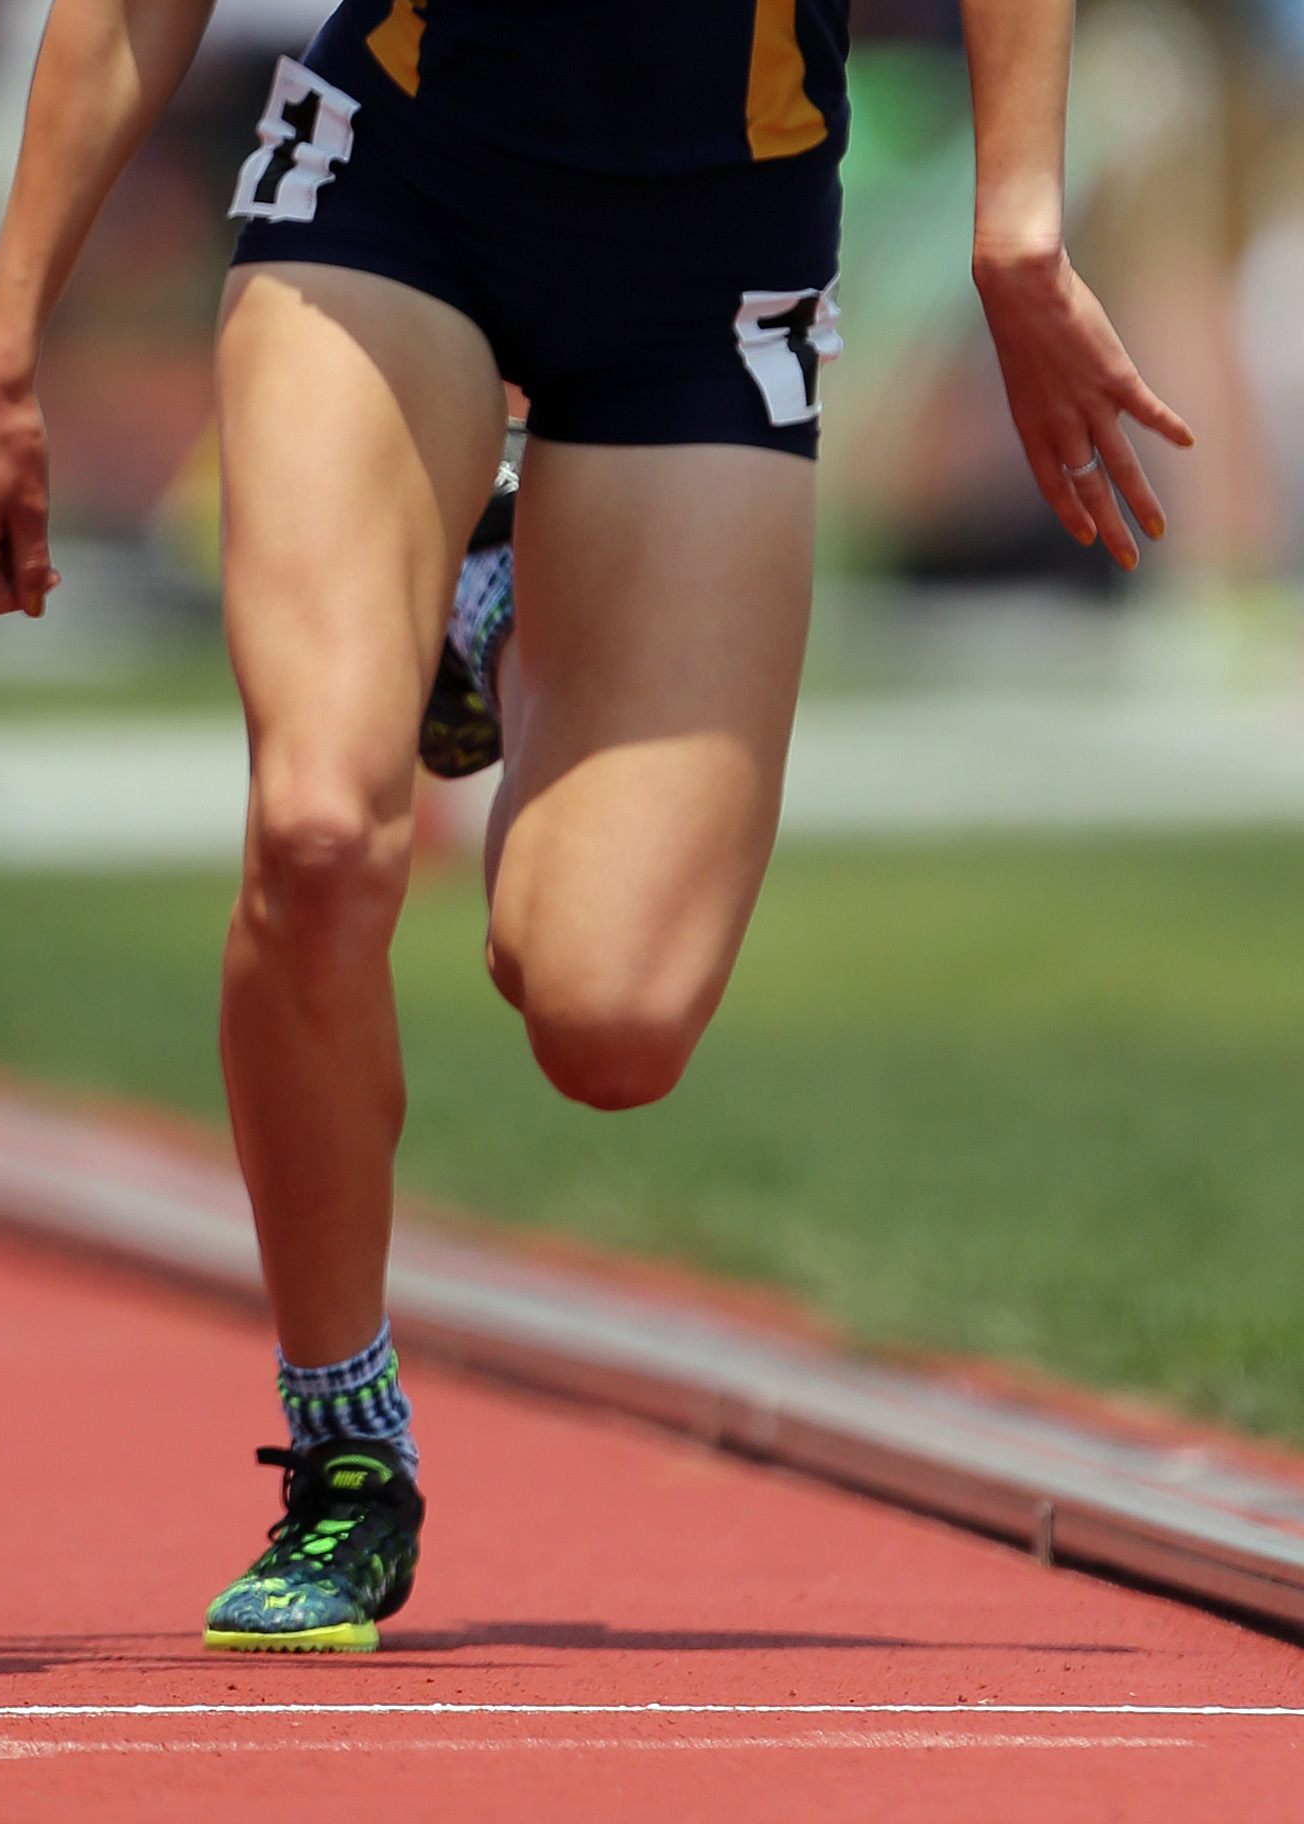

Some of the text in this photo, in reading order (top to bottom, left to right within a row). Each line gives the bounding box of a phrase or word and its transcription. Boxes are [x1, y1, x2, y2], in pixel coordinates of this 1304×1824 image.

[253, 87, 323, 204] 1
[756, 296, 821, 407] 1
[333, 1470, 368, 1489] NIKE
